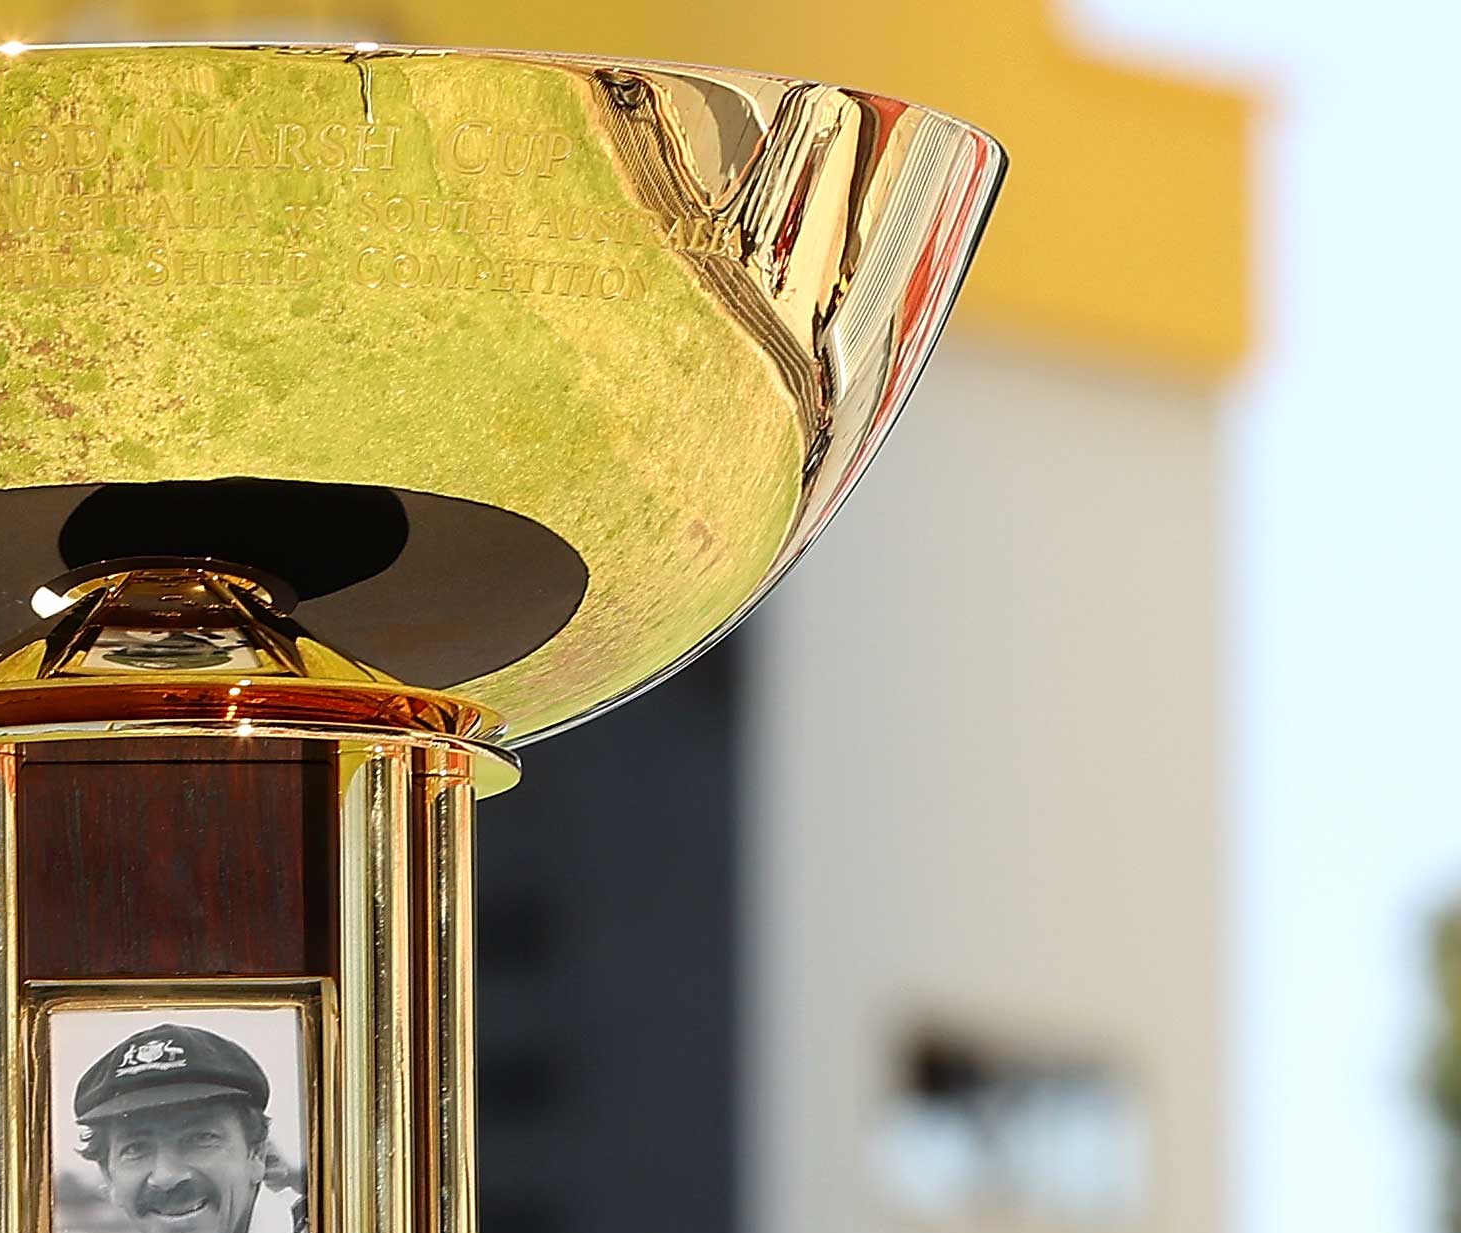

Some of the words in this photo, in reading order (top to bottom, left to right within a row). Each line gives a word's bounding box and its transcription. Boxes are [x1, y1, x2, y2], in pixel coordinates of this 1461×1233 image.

[155, 117, 402, 173] MARSH
[449, 119, 577, 178] CUP
[357, 191, 513, 238] SOUTH
[527, 203, 745, 261] AUSTRALIA
[140, 243, 318, 289] SHIELD
[354, 246, 654, 301] COMPETITION
